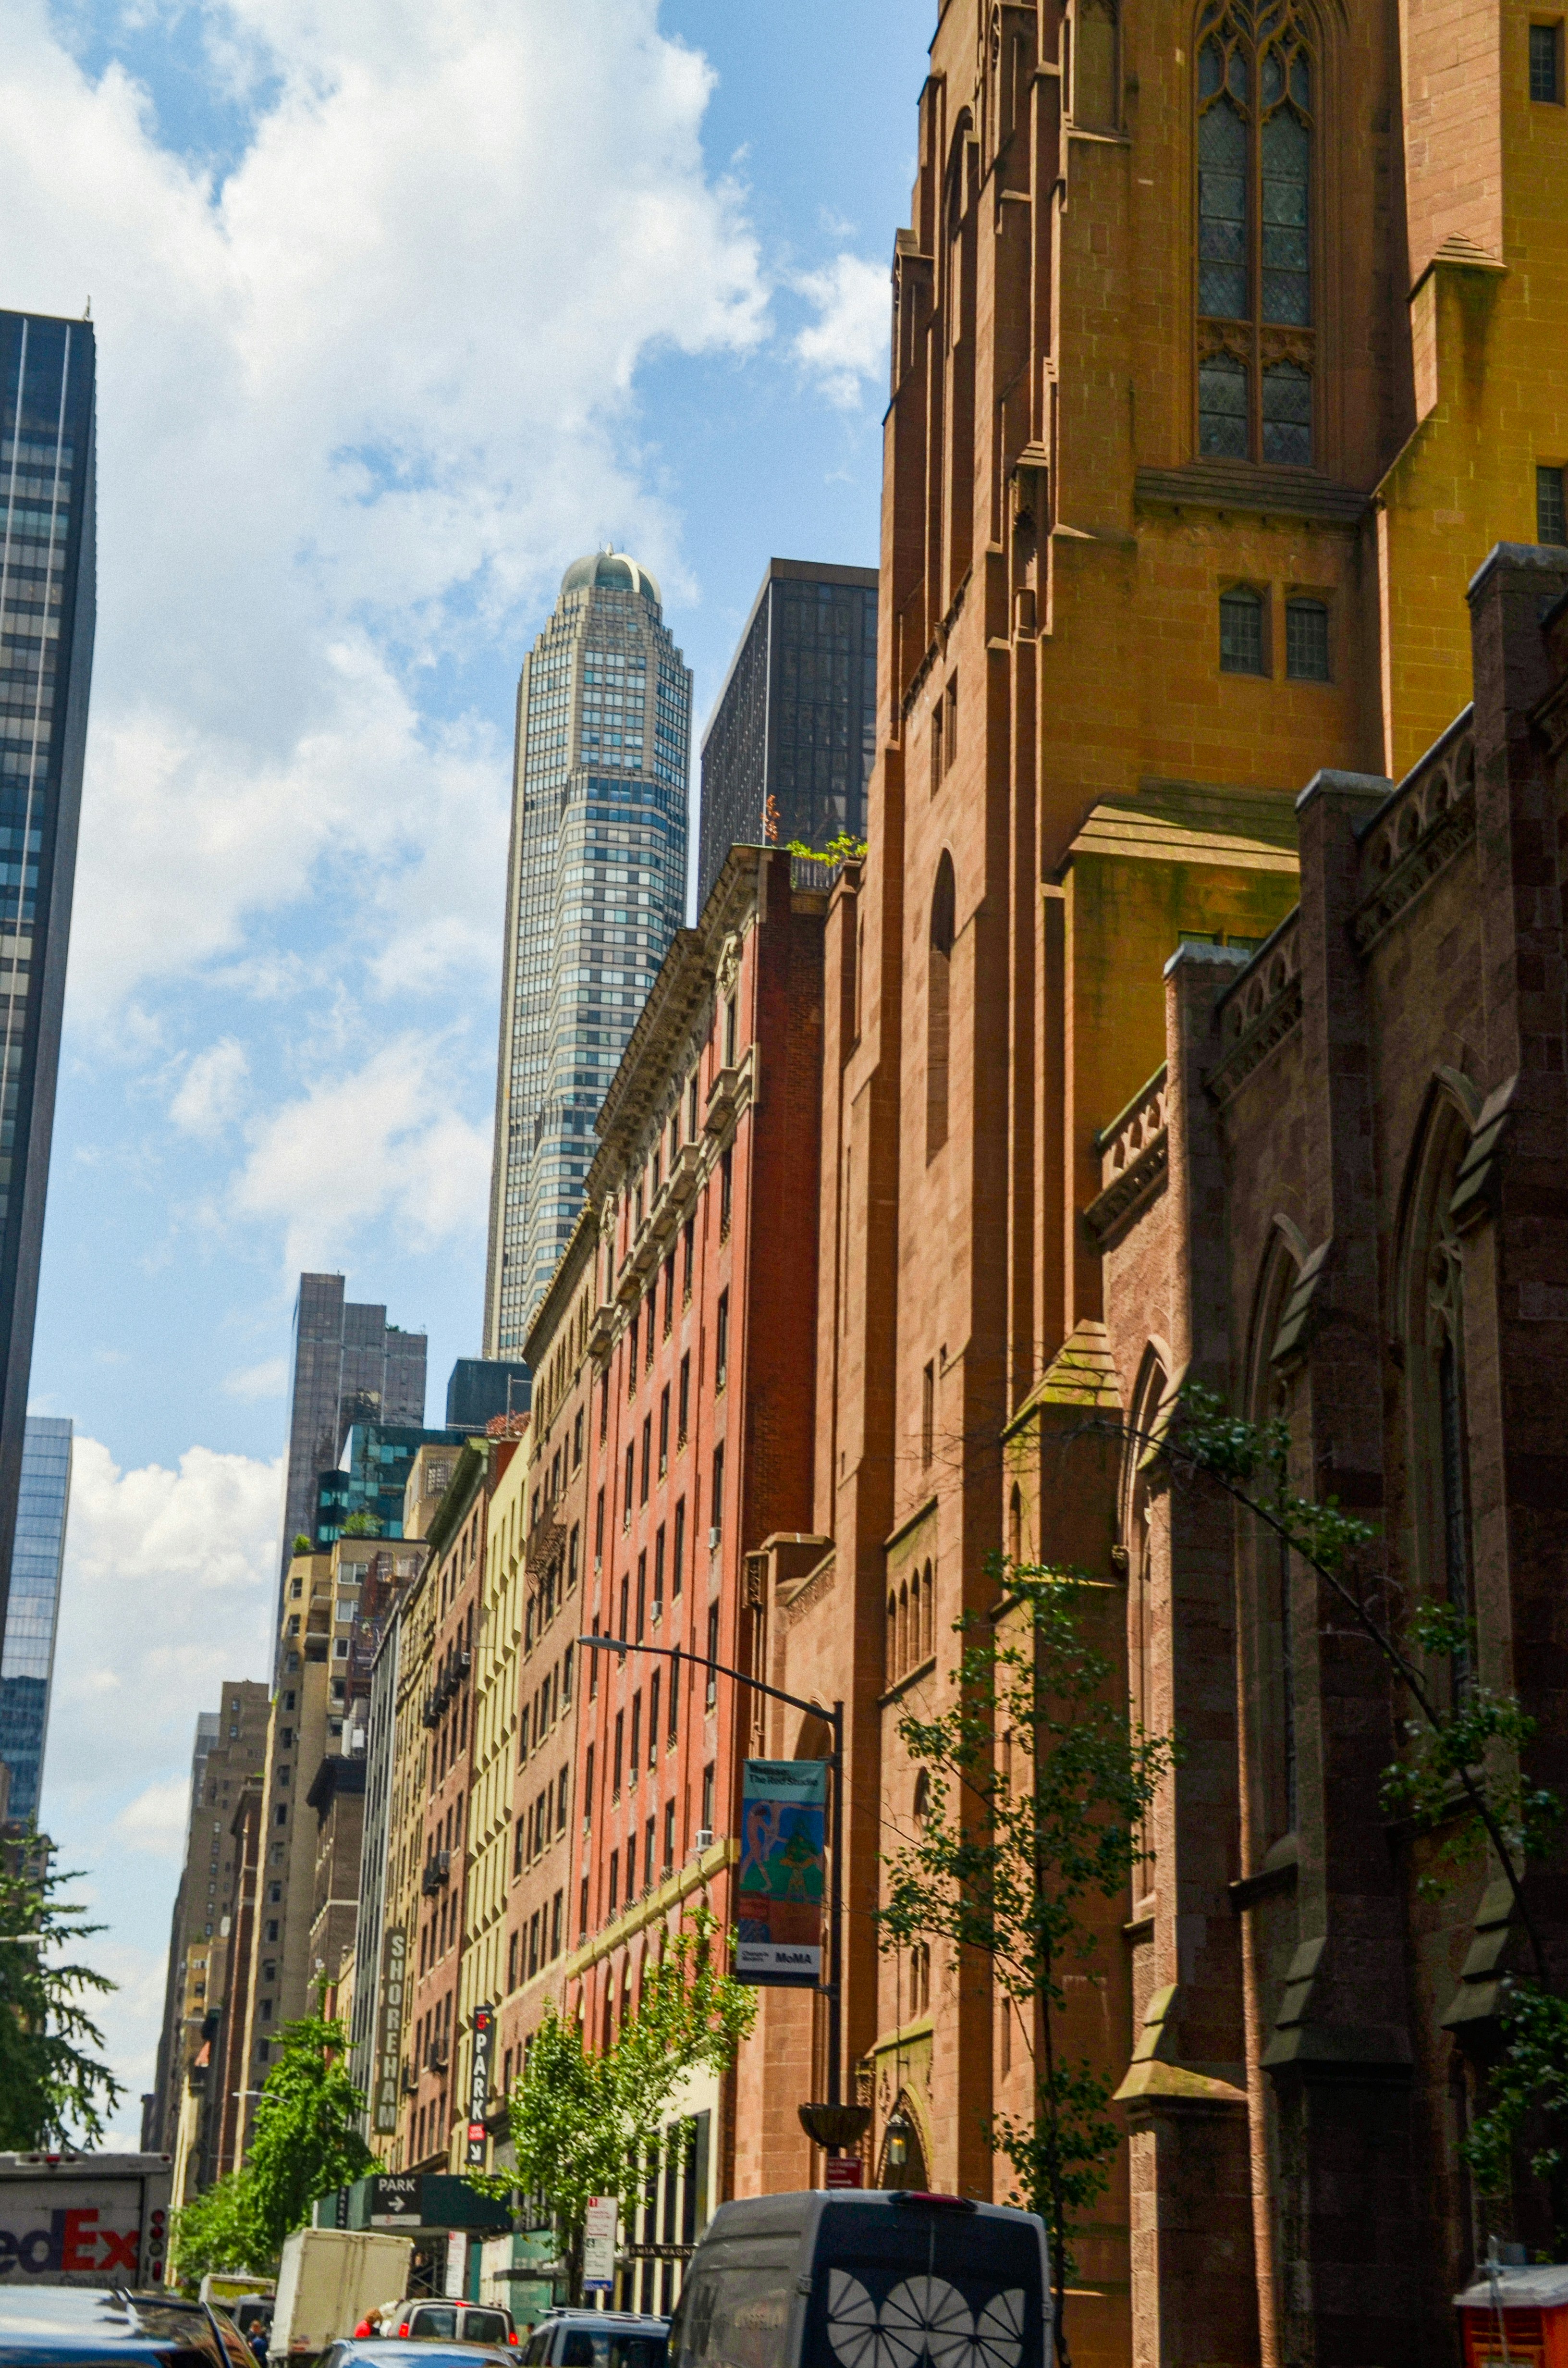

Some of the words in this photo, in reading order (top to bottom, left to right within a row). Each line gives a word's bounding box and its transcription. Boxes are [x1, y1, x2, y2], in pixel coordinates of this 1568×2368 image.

[775, 1952, 812, 1964] MoMA
[378, 1936, 404, 2127] SHOREHAM
[472, 2033, 487, 2121] PARK
[378, 2178, 416, 2192] PARK
